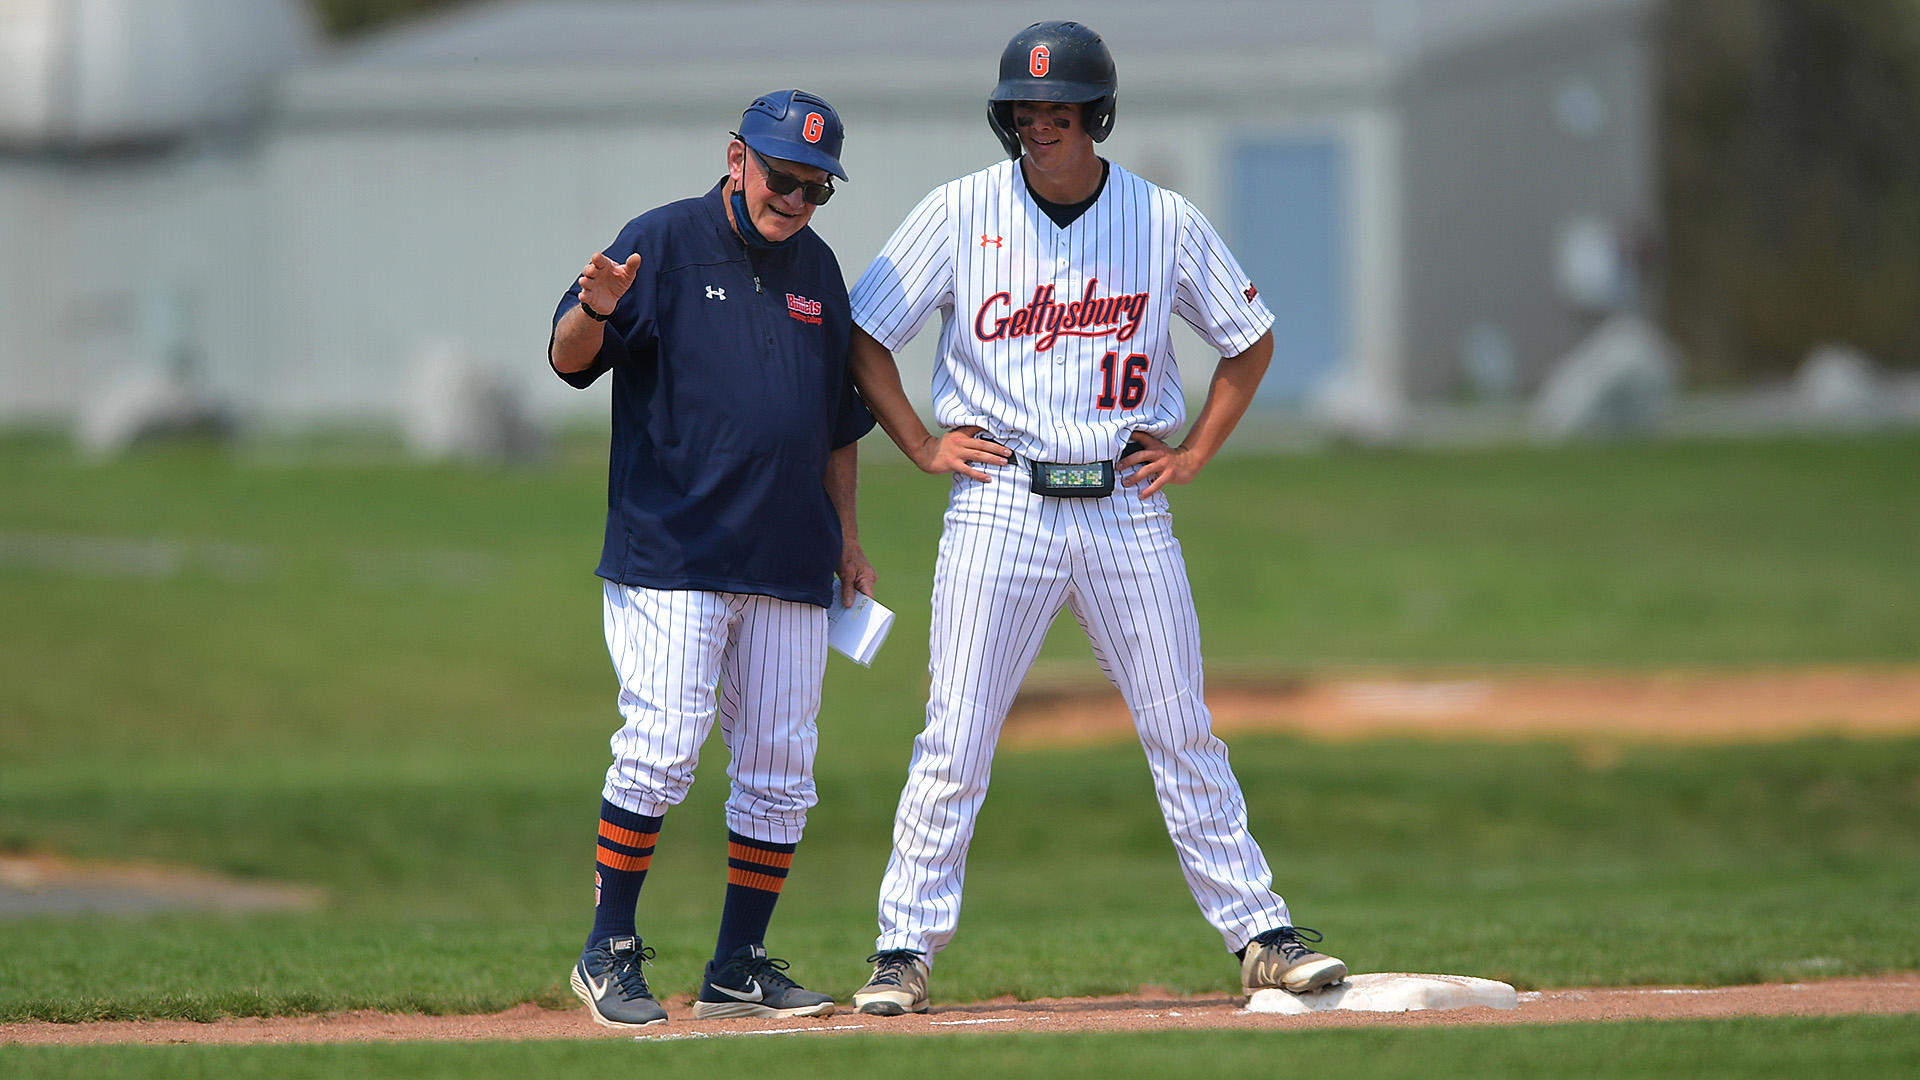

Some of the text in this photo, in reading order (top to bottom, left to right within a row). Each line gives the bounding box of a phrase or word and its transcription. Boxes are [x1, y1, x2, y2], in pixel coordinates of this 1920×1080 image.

[1029, 45, 1050, 77] G
[802, 112, 825, 143] G
[975, 278, 1149, 352] Gettysburg
[1096, 351, 1150, 410] 16
